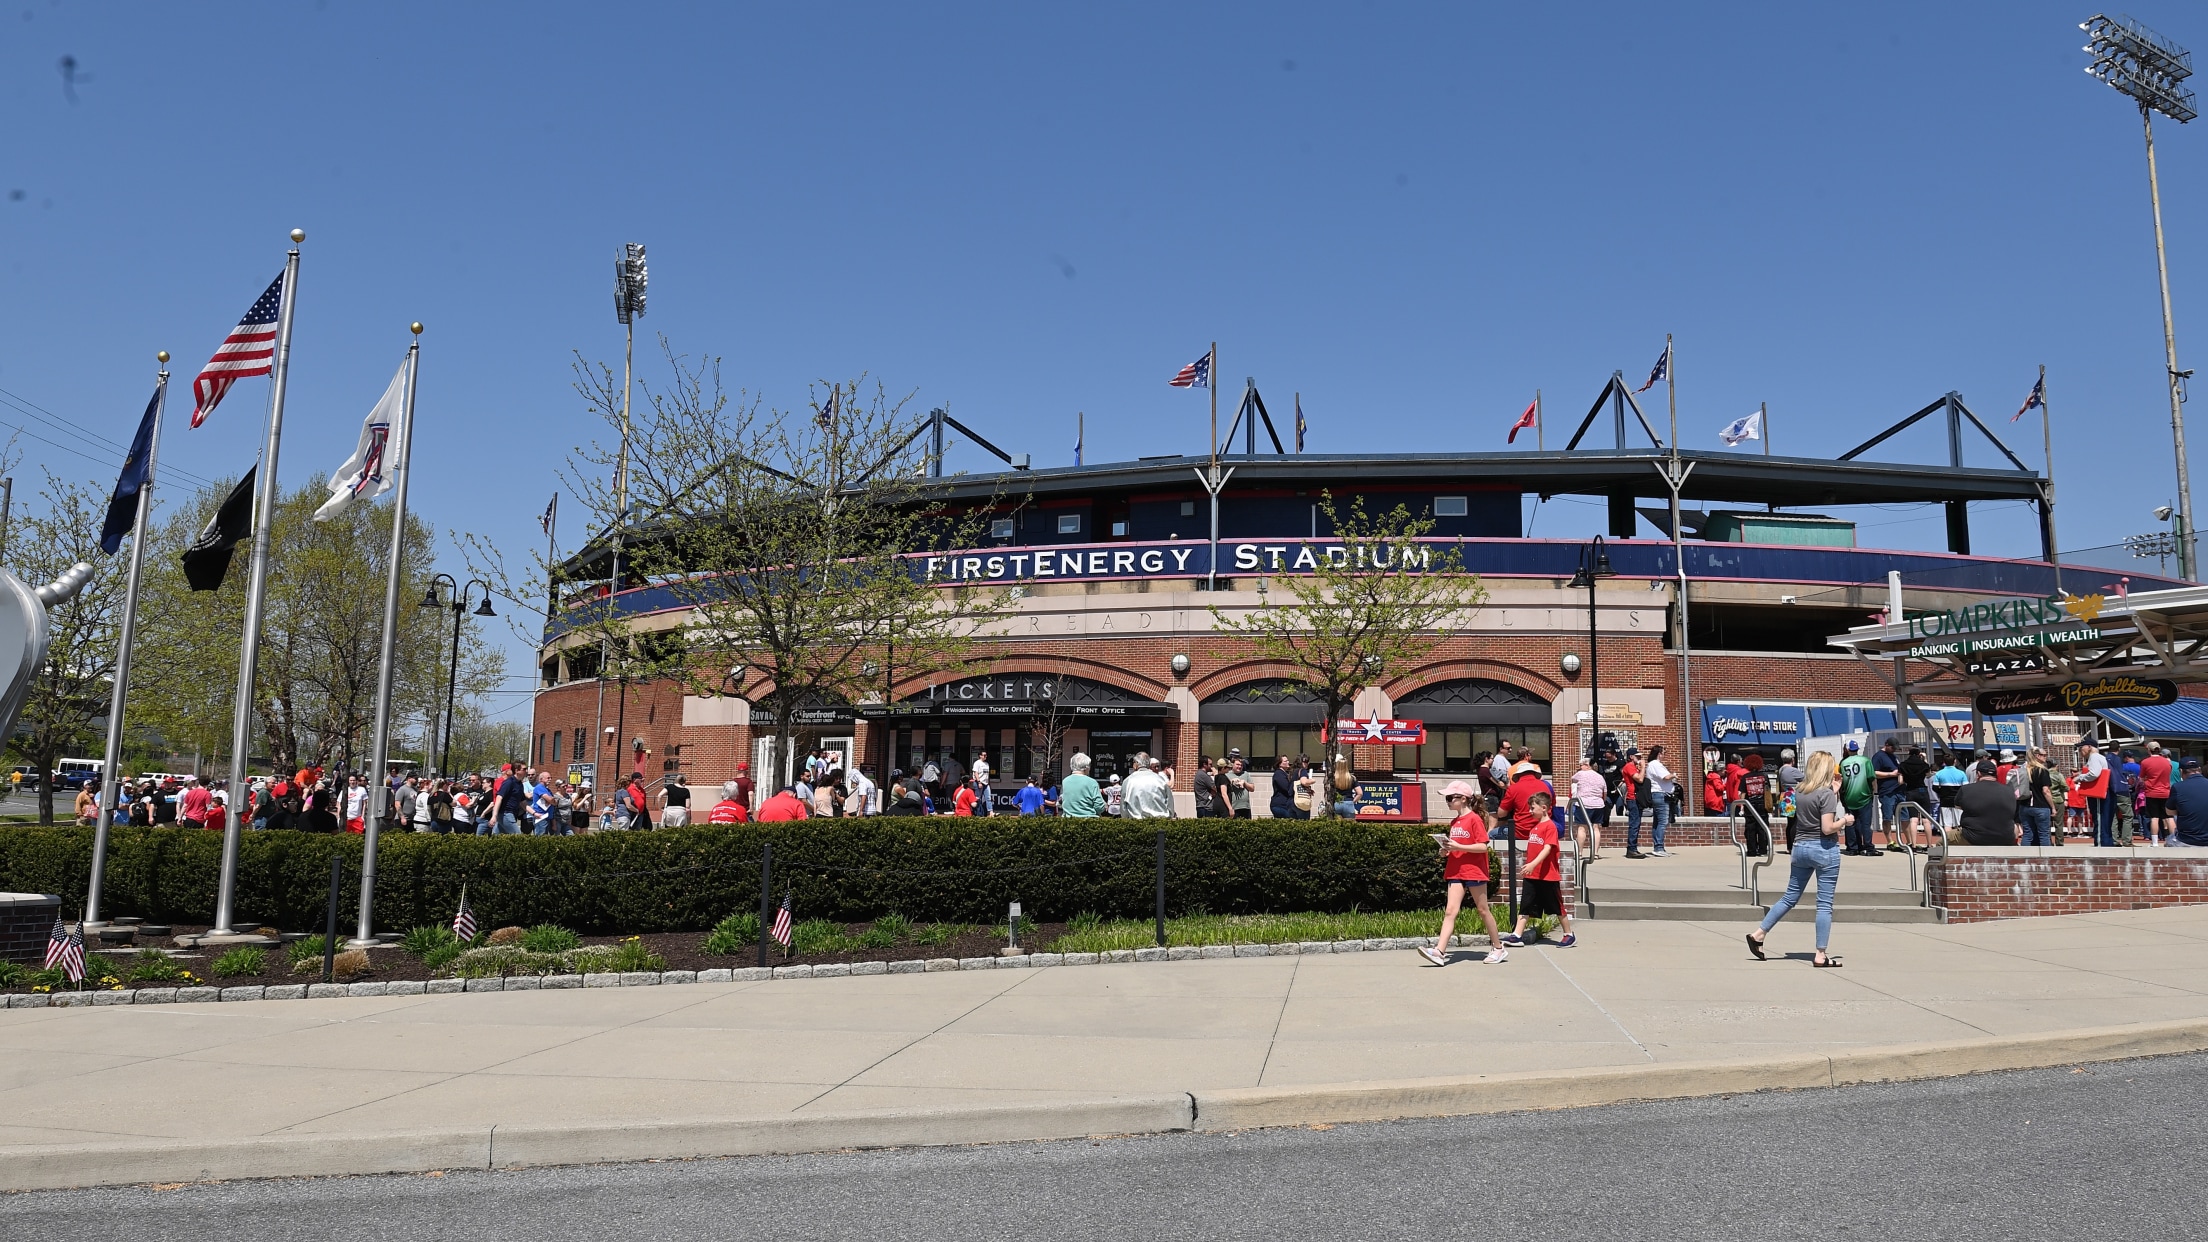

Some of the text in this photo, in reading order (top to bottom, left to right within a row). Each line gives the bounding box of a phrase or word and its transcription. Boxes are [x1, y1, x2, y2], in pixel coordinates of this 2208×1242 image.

[1235, 544, 1431, 569] STADIUM
[1902, 595, 2062, 638] TOMPKINS
[1911, 629, 2099, 657] BANKING INSURANCE WEALTH
[1970, 659, 2036, 672] PLAZA
[929, 682, 1052, 700] TICKETS
[1990, 677, 2161, 711] Welcome to Baseballtown
[1011, 705, 1032, 713] OFFICE
[1076, 706, 1098, 714] FRONT
[750, 710, 777, 721] SAVAG
[1393, 720, 1407, 729] Star
[1751, 721, 1770, 731] TEAM
[1772, 721, 1797, 731] STORE
[1996, 723, 2018, 733] TEAM
[1996, 733, 2020, 743] STORE
[1844, 762, 1861, 778] 50
[1386, 798, 1398, 806] $19
